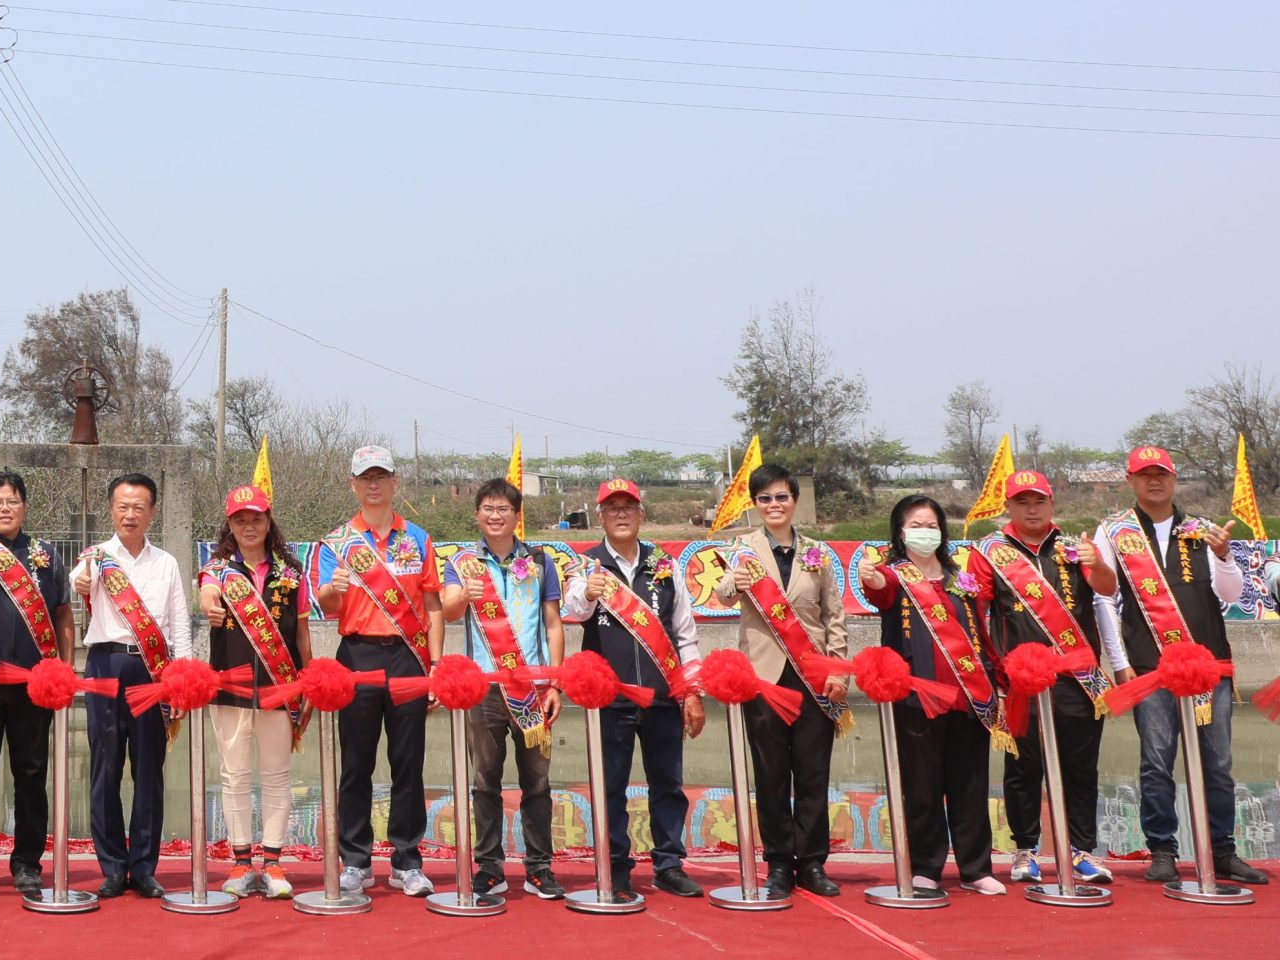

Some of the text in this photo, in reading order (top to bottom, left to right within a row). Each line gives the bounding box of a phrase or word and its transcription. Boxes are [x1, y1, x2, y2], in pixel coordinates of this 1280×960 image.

[1177, 538, 1194, 583] 袋鎮民代表會
[1059, 565, 1078, 610] 袋鎮民代表會
